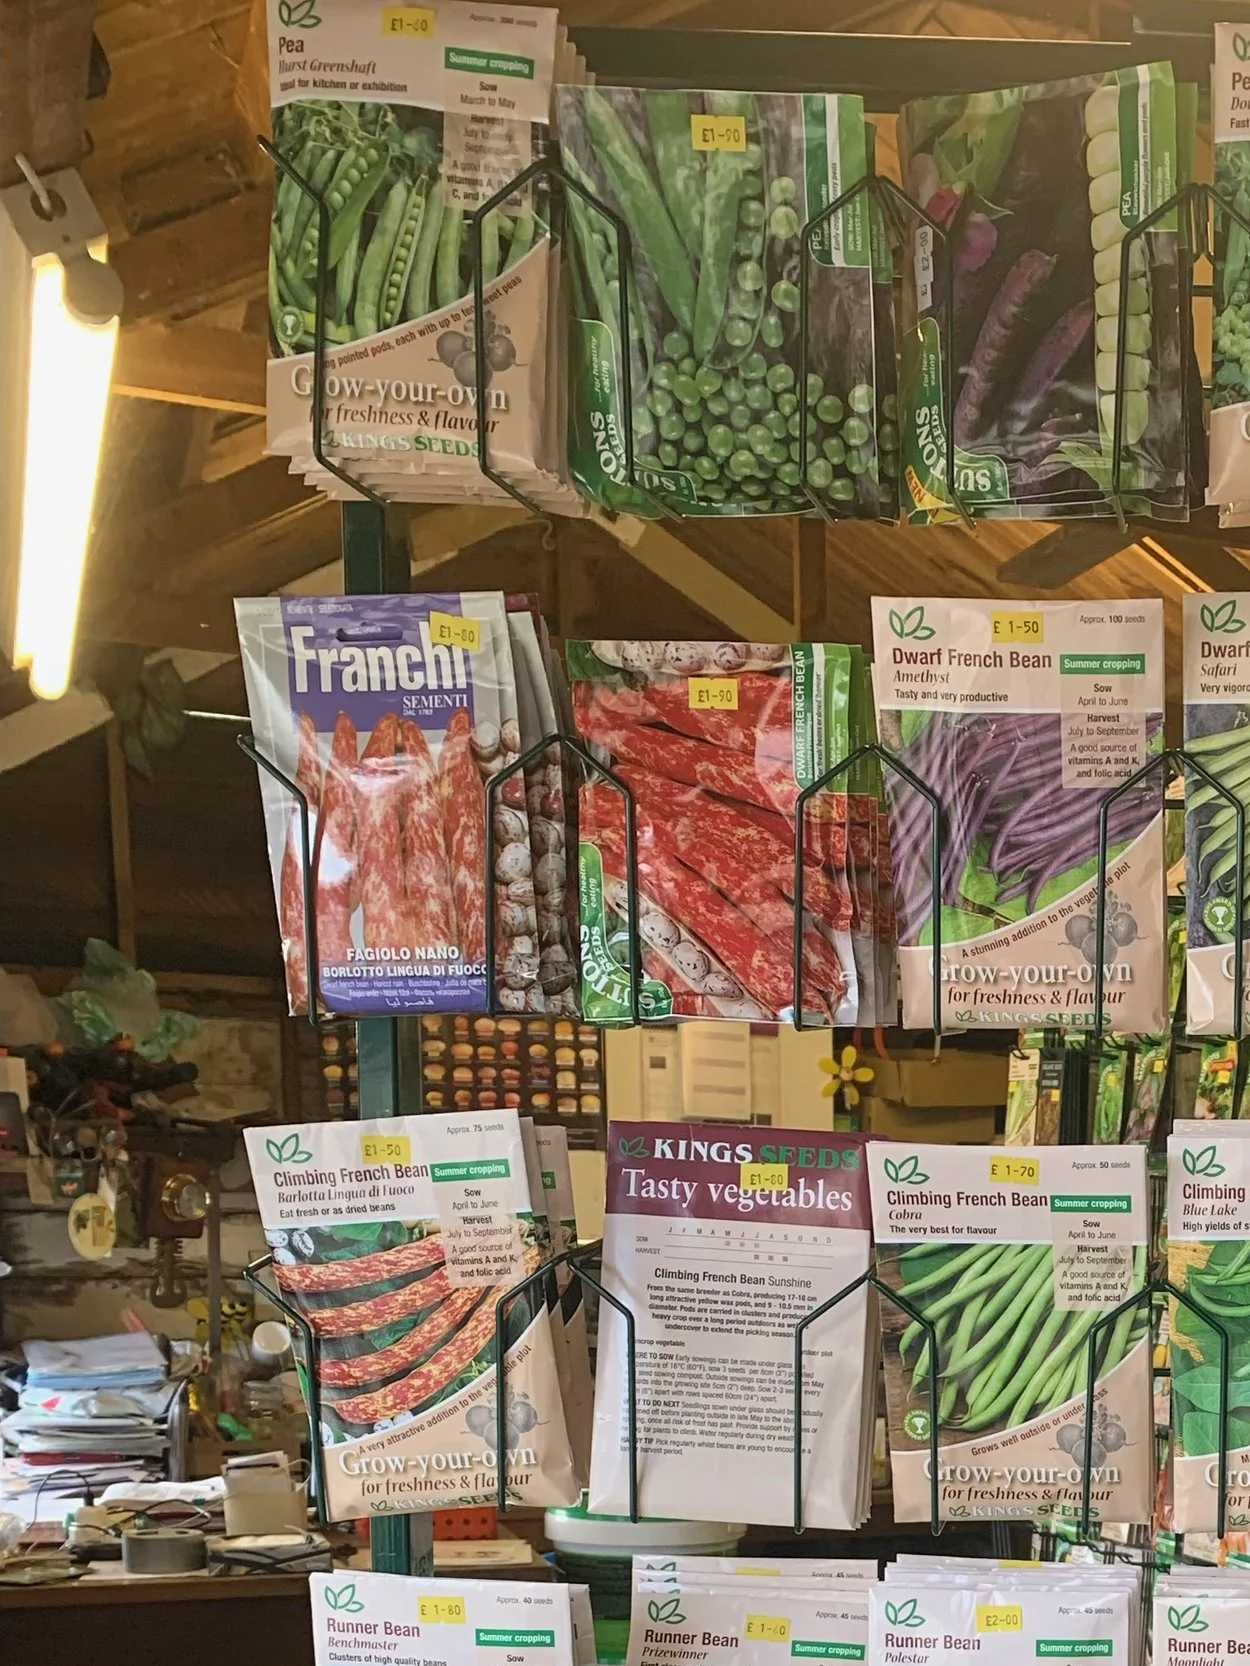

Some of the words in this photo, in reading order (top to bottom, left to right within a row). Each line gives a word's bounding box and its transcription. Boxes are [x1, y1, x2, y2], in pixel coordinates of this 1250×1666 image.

[279, 36, 304, 55] Pea
[702, 127, 740, 144] £1-90
[439, 626, 475, 644] £1-80
[1201, 640, 1250, 659] Dwarf
[893, 648, 941, 669] Dwarf
[948, 649, 1004, 668] French
[1009, 649, 1052, 668] Bean
[894, 670, 950, 686] Amethyst
[1200, 663, 1237, 678] Safari
[1200, 683, 1221, 694] Very
[403, 694, 468, 709] SEMENTI
[698, 689, 732, 704] £1-90
[346, 947, 401, 960] FAGIOLO
[416, 946, 459, 960] NANO
[323, 965, 384, 977] BORLOTTO
[387, 965, 430, 977] LINGUA
[434, 965, 445, 976] DI
[364, 1145, 402, 1157] £1-50
[653, 1139, 752, 1161] KINGS
[278, 1189, 325, 1203] Barlotta
[329, 1187, 365, 1203] Lingua
[369, 1186, 380, 1197] di
[383, 1184, 414, 1197] Fuoco
[622, 1168, 697, 1207] Tasty
[1183, 1183, 1246, 1203] Climbing
[887, 1191, 951, 1209] Climbing
[956, 1192, 1007, 1207] French
[1012, 1193, 1047, 1207] Bean
[889, 1209, 921, 1222] Cobra
[1183, 1203, 1209, 1216] Blue
[1213, 1204, 1237, 1217] Lake
[890, 1225, 905, 1234] The
[909, 1226, 925, 1236] very
[929, 1225, 949, 1234] best
[952, 1225, 964, 1235] for
[967, 1225, 997, 1235] flavour
[655, 1268, 699, 1284] Climbing
[702, 1271, 740, 1284] French
[743, 1273, 765, 1285] Bean
[768, 1274, 812, 1288] Sunshine
[328, 1618, 379, 1636] Runner
[384, 1621, 420, 1638] Bean
[985, 1615, 1018, 1627] £2-00
[328, 1637, 398, 1651] Benchmaster
[885, 1634, 934, 1650] Runner
[940, 1635, 980, 1651] Bean
[642, 1647, 709, 1660] Prizewinner
[885, 1651, 929, 1665] Polestar
